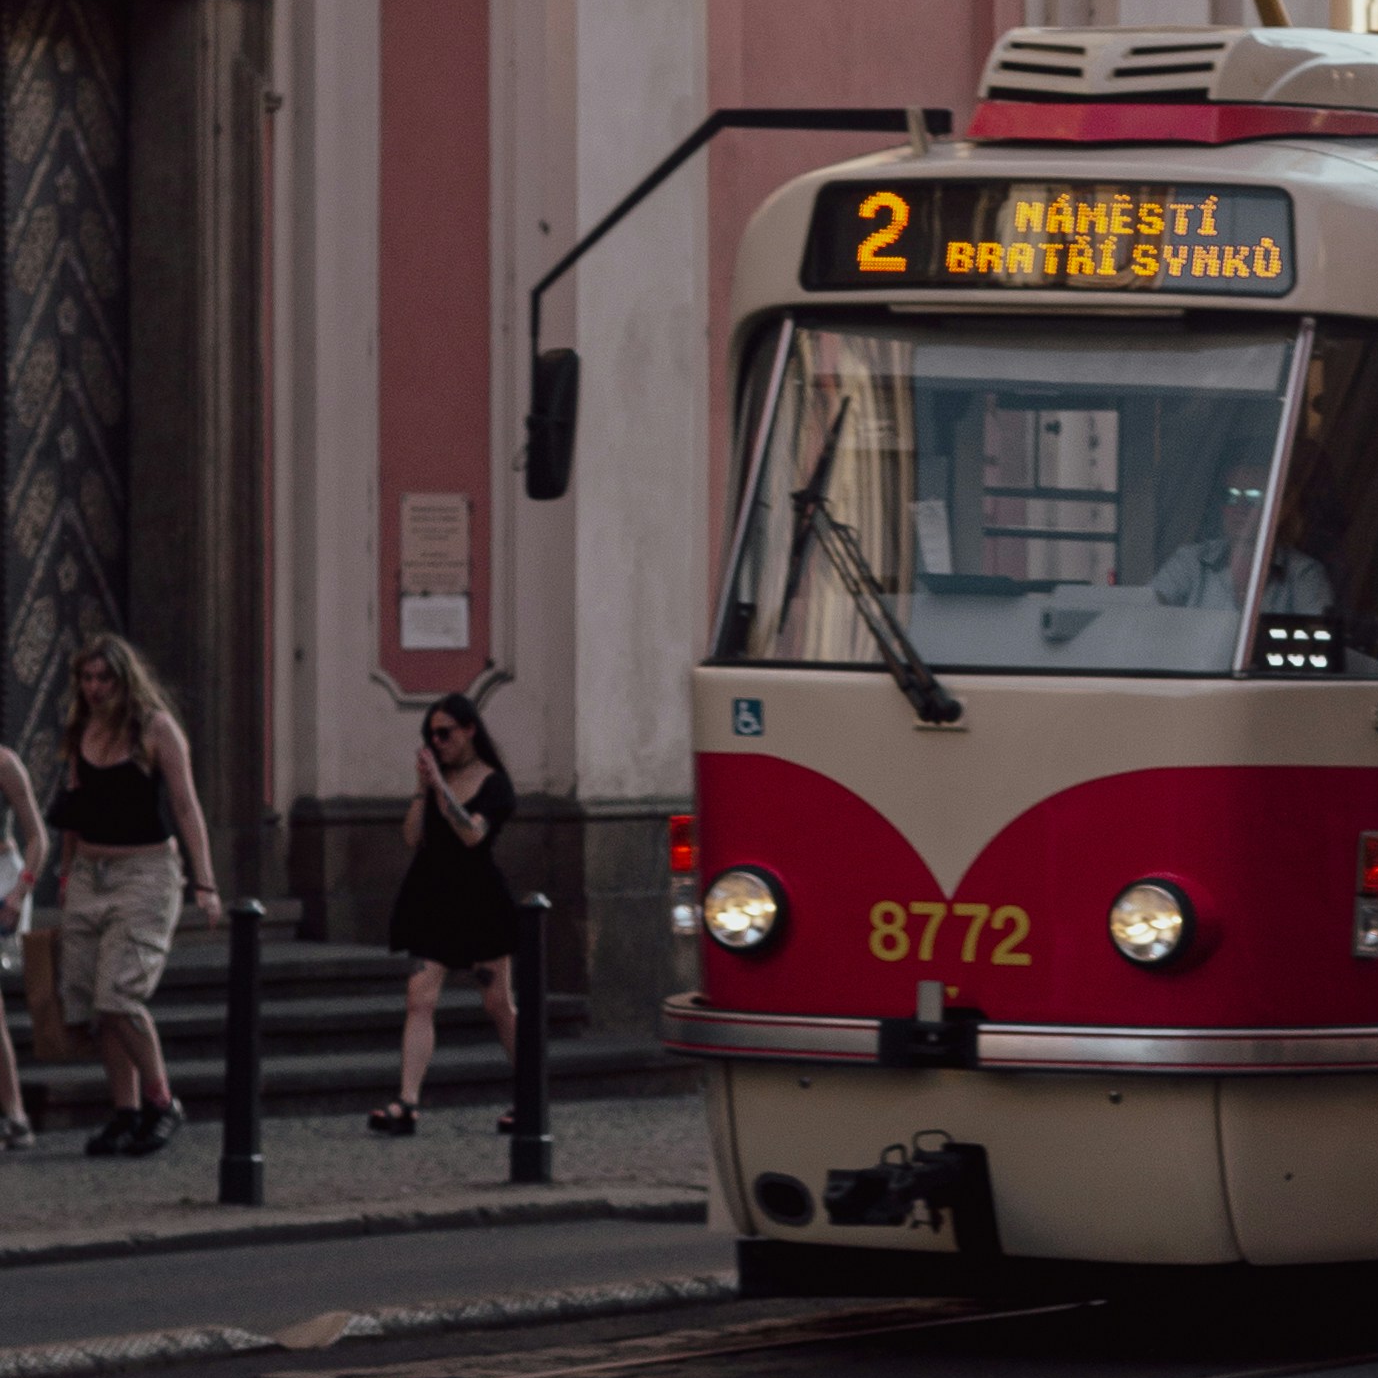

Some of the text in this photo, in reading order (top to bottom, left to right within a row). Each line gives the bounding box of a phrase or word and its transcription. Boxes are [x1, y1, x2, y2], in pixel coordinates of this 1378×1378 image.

[856, 191, 910, 273] 2
[1015, 194, 1219, 237] NÁMĚSTÍ
[945, 236, 1283, 279] BRATŘÍ SYNKŮ
[869, 900, 1033, 967] 8772
